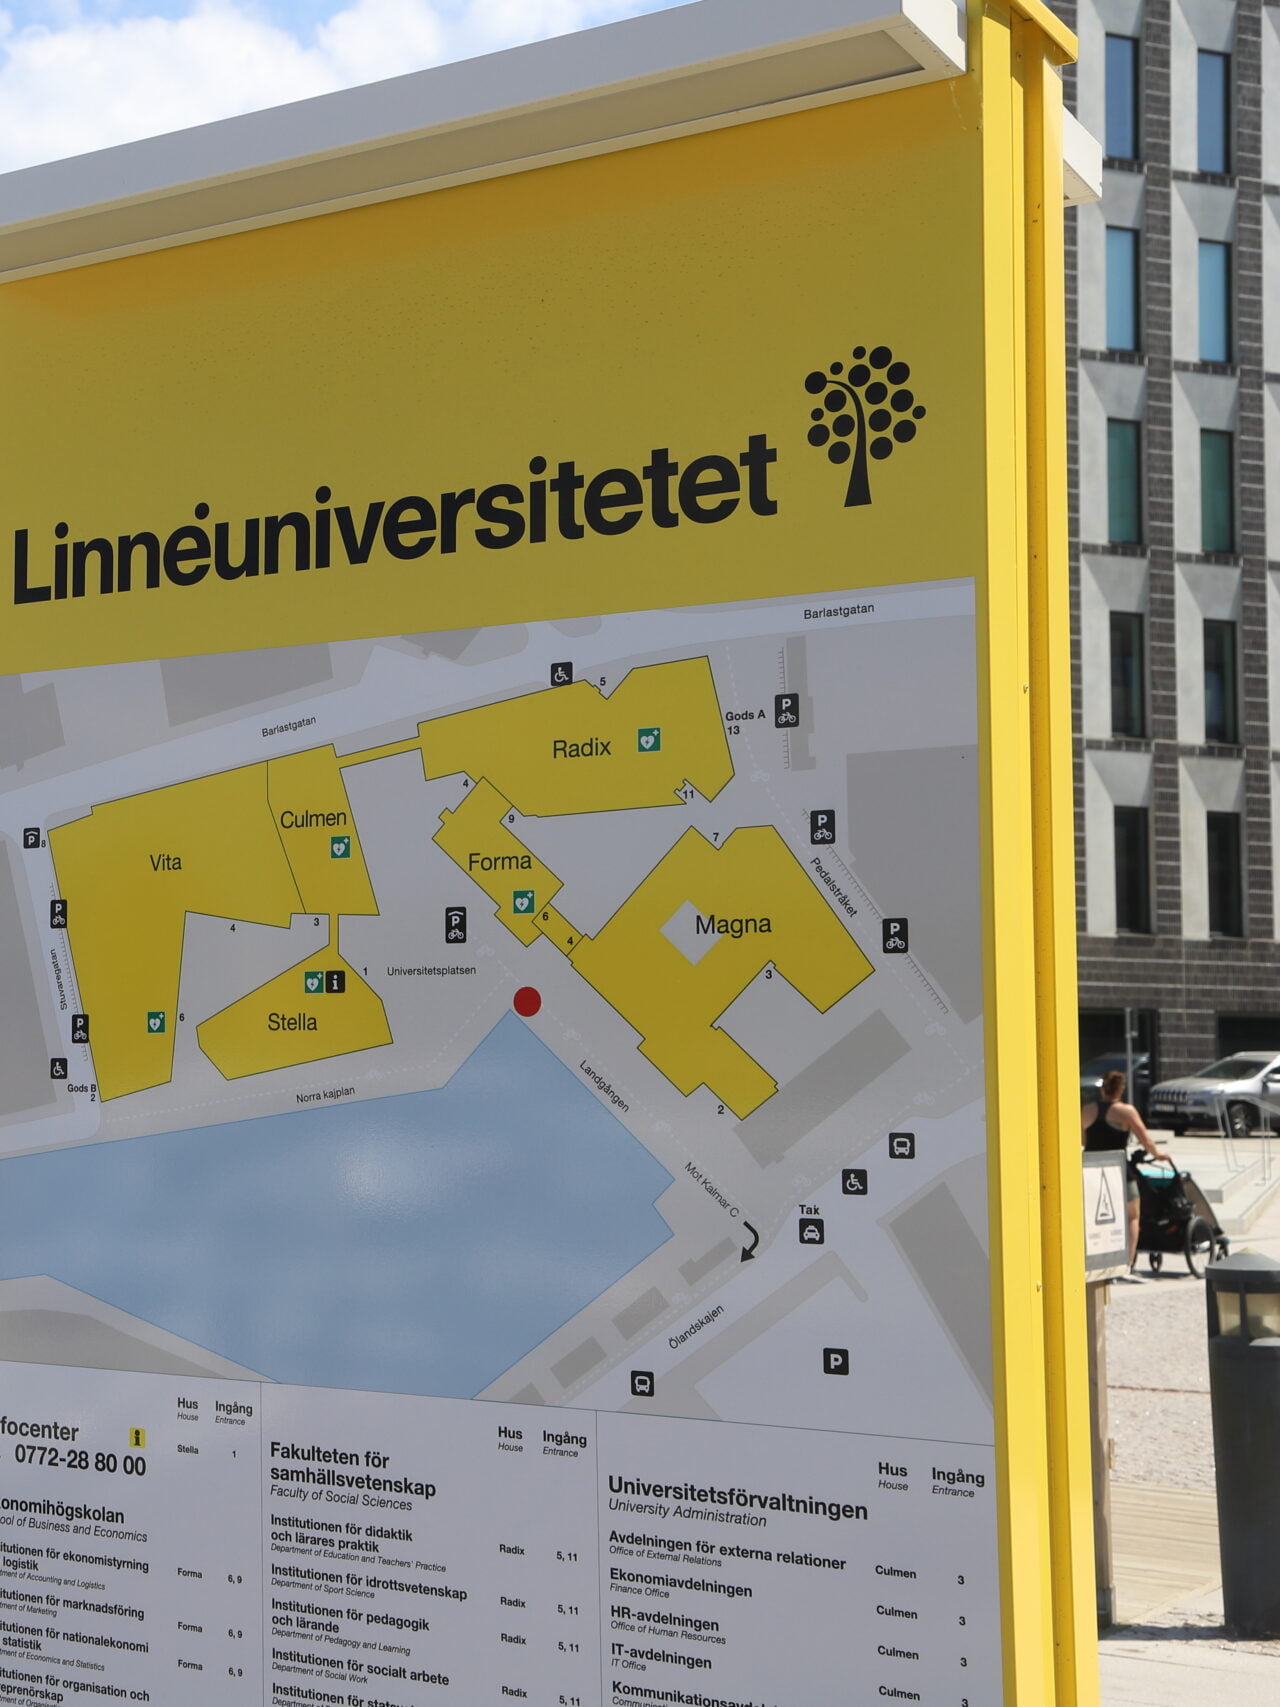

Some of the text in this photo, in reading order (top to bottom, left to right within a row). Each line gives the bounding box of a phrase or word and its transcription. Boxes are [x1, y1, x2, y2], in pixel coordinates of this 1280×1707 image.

[803, 602, 875, 621] Barlastgatan
[600, 676, 606, 686] 5
[725, 709, 766, 723] Gods A
[262, 716, 317, 737] Barlastgatan
[727, 725, 740, 736] 13
[552, 738, 612, 759] Radix
[463, 779, 469, 788] 4
[683, 789, 694, 800] 11
[280, 810, 347, 829] Culmen
[508, 815, 515, 823] 9
[41, 839, 46, 848] 8
[713, 832, 720, 842] 7
[150, 854, 182, 872] Vita
[468, 853, 532, 871] Forma
[810, 857, 858, 918] Pedalstråket
[313, 918, 320, 927] 3
[542, 912, 549, 921] 6
[230, 924, 236, 933] 4
[695, 913, 772, 939] Magna
[567, 937, 574, 946] 4
[363, 967, 368, 976] 1
[387, 965, 476, 978] Universitetsplatsen
[765, 970, 773, 980] 3
[49, 948, 67, 1010] Stuvaregatan
[179, 1013, 185, 1022] 6
[268, 1013, 318, 1031] Stella
[67, 1083, 97, 1094] Gods B
[579, 1059, 630, 1113] Landgången
[90, 1094, 96, 1102] 2
[296, 1086, 355, 1103] Norra kajplan
[717, 1105, 725, 1115] 2
[684, 1161, 740, 1218] Mot Kalmar C
[668, 1304, 725, 1350] Ölandskajen
[177, 1396, 198, 1410] Hus
[215, 1400, 252, 1418] Ingång
[176, 1412, 198, 1421] House
[214, 1415, 245, 1426] Entrance
[498, 1426, 522, 1440] Hus
[542, 1430, 586, 1449] Ingång
[177, 1444, 198, 1455] Stella
[497, 1442, 523, 1452] House
[542, 1446, 578, 1458] Entrance
[14, 1444, 146, 1476] 0772-28 80 00
[270, 1442, 389, 1468] Fakulteten för
[878, 1462, 907, 1477] Hus
[270, 1468, 436, 1499] samhällsvetenskap
[931, 1467, 984, 1488] Ingång
[877, 1479, 908, 1491] House
[931, 1485, 974, 1498] Entrance
[270, 1484, 412, 1511] Faculty of Social Sciences
[608, 1475, 867, 1521] Universitetsförvaltningen
[608, 1498, 766, 1527] University Administration
[16, 1517, 26, 1528] of
[27, 1517, 70, 1533] Business
[72, 1524, 91, 1536] and
[93, 1525, 147, 1542] Economics
[270, 1514, 412, 1542] Institutionen för didaktik
[270, 1532, 379, 1554] och lärares praktik
[499, 1544, 524, 1556] Radix
[608, 1529, 846, 1570] Avdelningen för externa relationer
[45, 1547, 60, 1559] för
[62, 1550, 148, 1573] ekonomistyrning
[270, 1543, 446, 1572] Department of Education and Teachers' Practice
[556, 1551, 577, 1562] 5, 11
[608, 1545, 722, 1567] Office of External Relations
[2, 1556, 38, 1571] logistik
[177, 1567, 202, 1579] Forma
[874, 1564, 916, 1579] Culmen
[227, 1574, 242, 1585] 6, 9
[271, 1564, 467, 1601] Institutionen för idrottsvetenskap
[610, 1567, 752, 1598] Ekonomiavdelningen
[957, 1575, 964, 1585] 3
[609, 1583, 669, 1599] Finance Office
[45, 1593, 60, 1606] för
[62, 1598, 144, 1619] marknadsföring
[500, 1596, 525, 1608] Radix
[271, 1598, 429, 1632] Institutionen för pedagogik
[557, 1604, 578, 1616] 5, 11
[876, 1605, 917, 1620] Culmen
[271, 1616, 339, 1634] och lärande
[610, 1605, 719, 1632] HR-avdelningen
[958, 1617, 965, 1626] 3
[177, 1621, 202, 1633] Forma
[45, 1627, 60, 1640] för
[62, 1631, 148, 1653] nationalekonomi
[227, 1629, 242, 1640] 6, 9
[500, 1633, 526, 1646] Radix
[2, 1636, 41, 1650] statistik
[557, 1641, 578, 1653] 5, 11
[611, 1643, 711, 1670] IT-avdelningen
[877, 1645, 919, 1661] Culmen
[177, 1659, 202, 1671] Forma
[272, 1648, 449, 1686] Institutionen för socialt arbete
[610, 1658, 646, 1672] IT Office
[960, 1658, 967, 1667] 3
[228, 1667, 242, 1678] 6, 9
